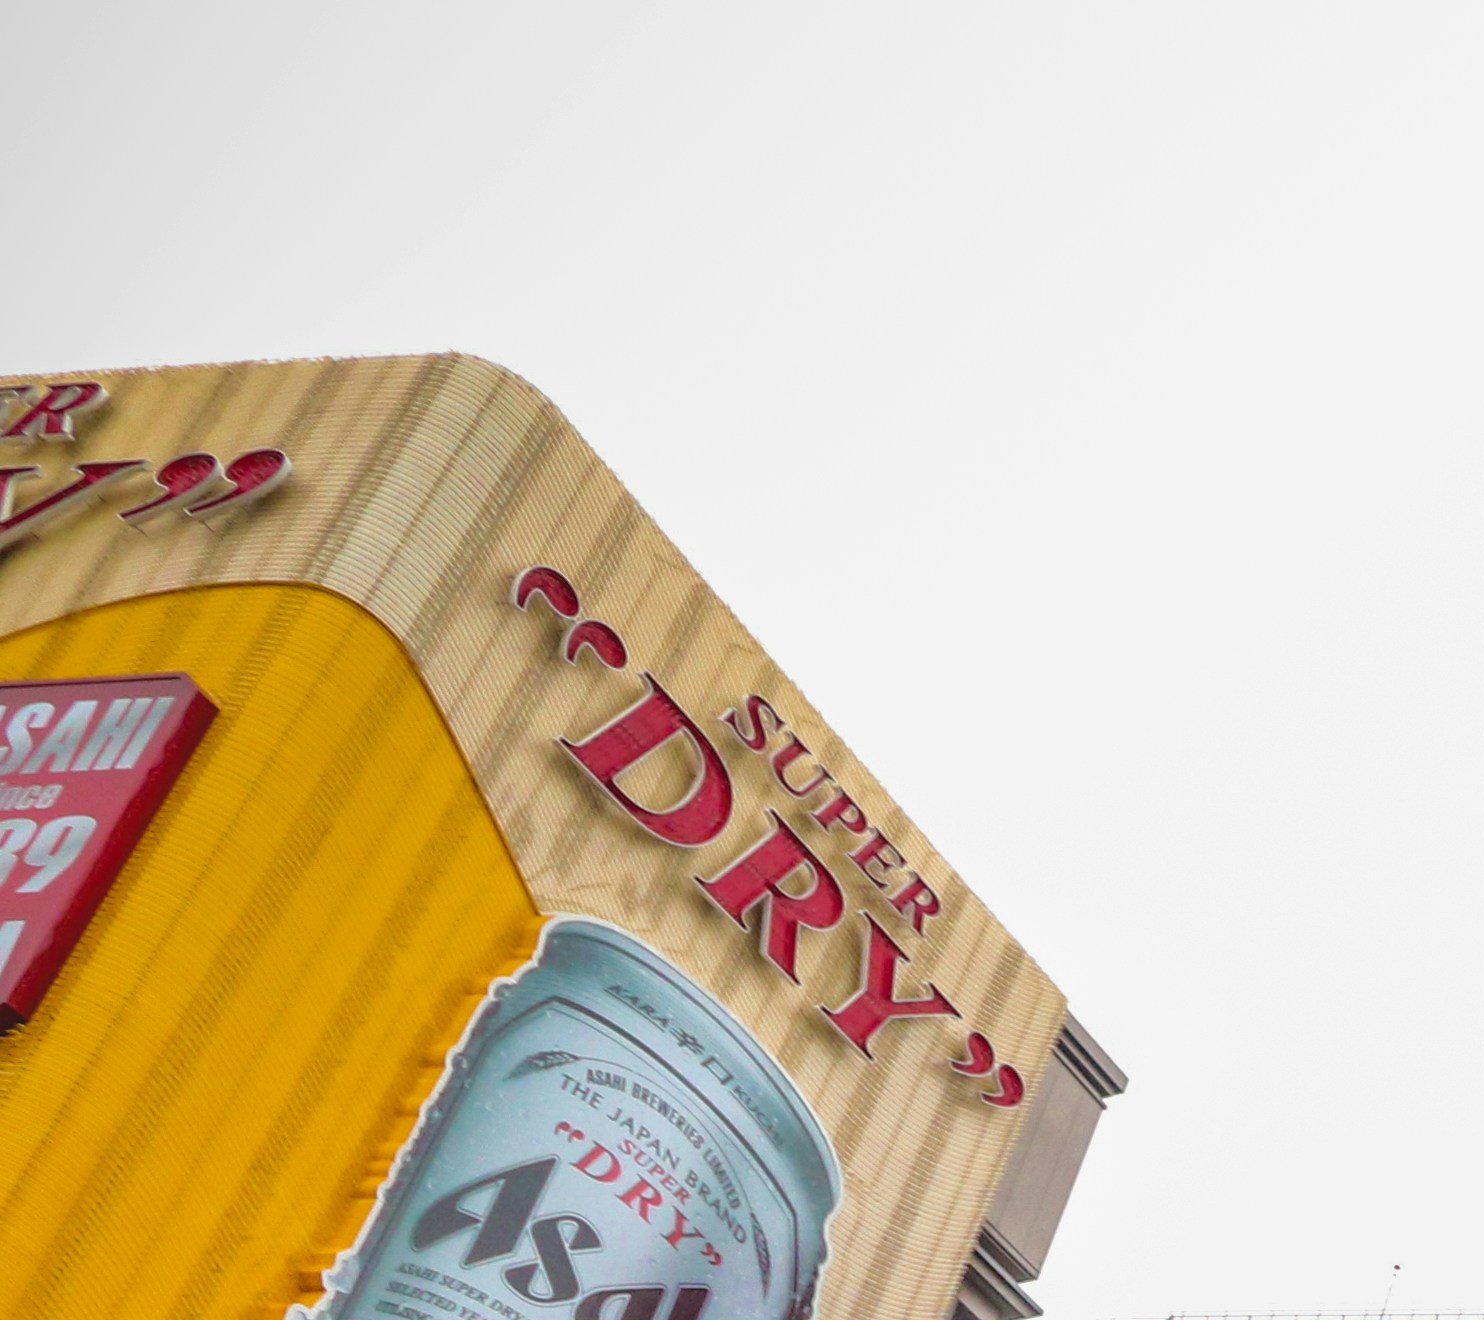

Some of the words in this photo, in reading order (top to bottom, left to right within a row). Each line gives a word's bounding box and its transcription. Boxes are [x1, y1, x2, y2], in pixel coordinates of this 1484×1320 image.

[0, 696, 176, 776] SAHI
[716, 691, 943, 937] SUPER
[561, 1073, 606, 1111] THE
[607, 1106, 682, 1171] JAPAN
[684, 1169, 747, 1245] BRAND
[618, 1139, 693, 1204] SUPER
